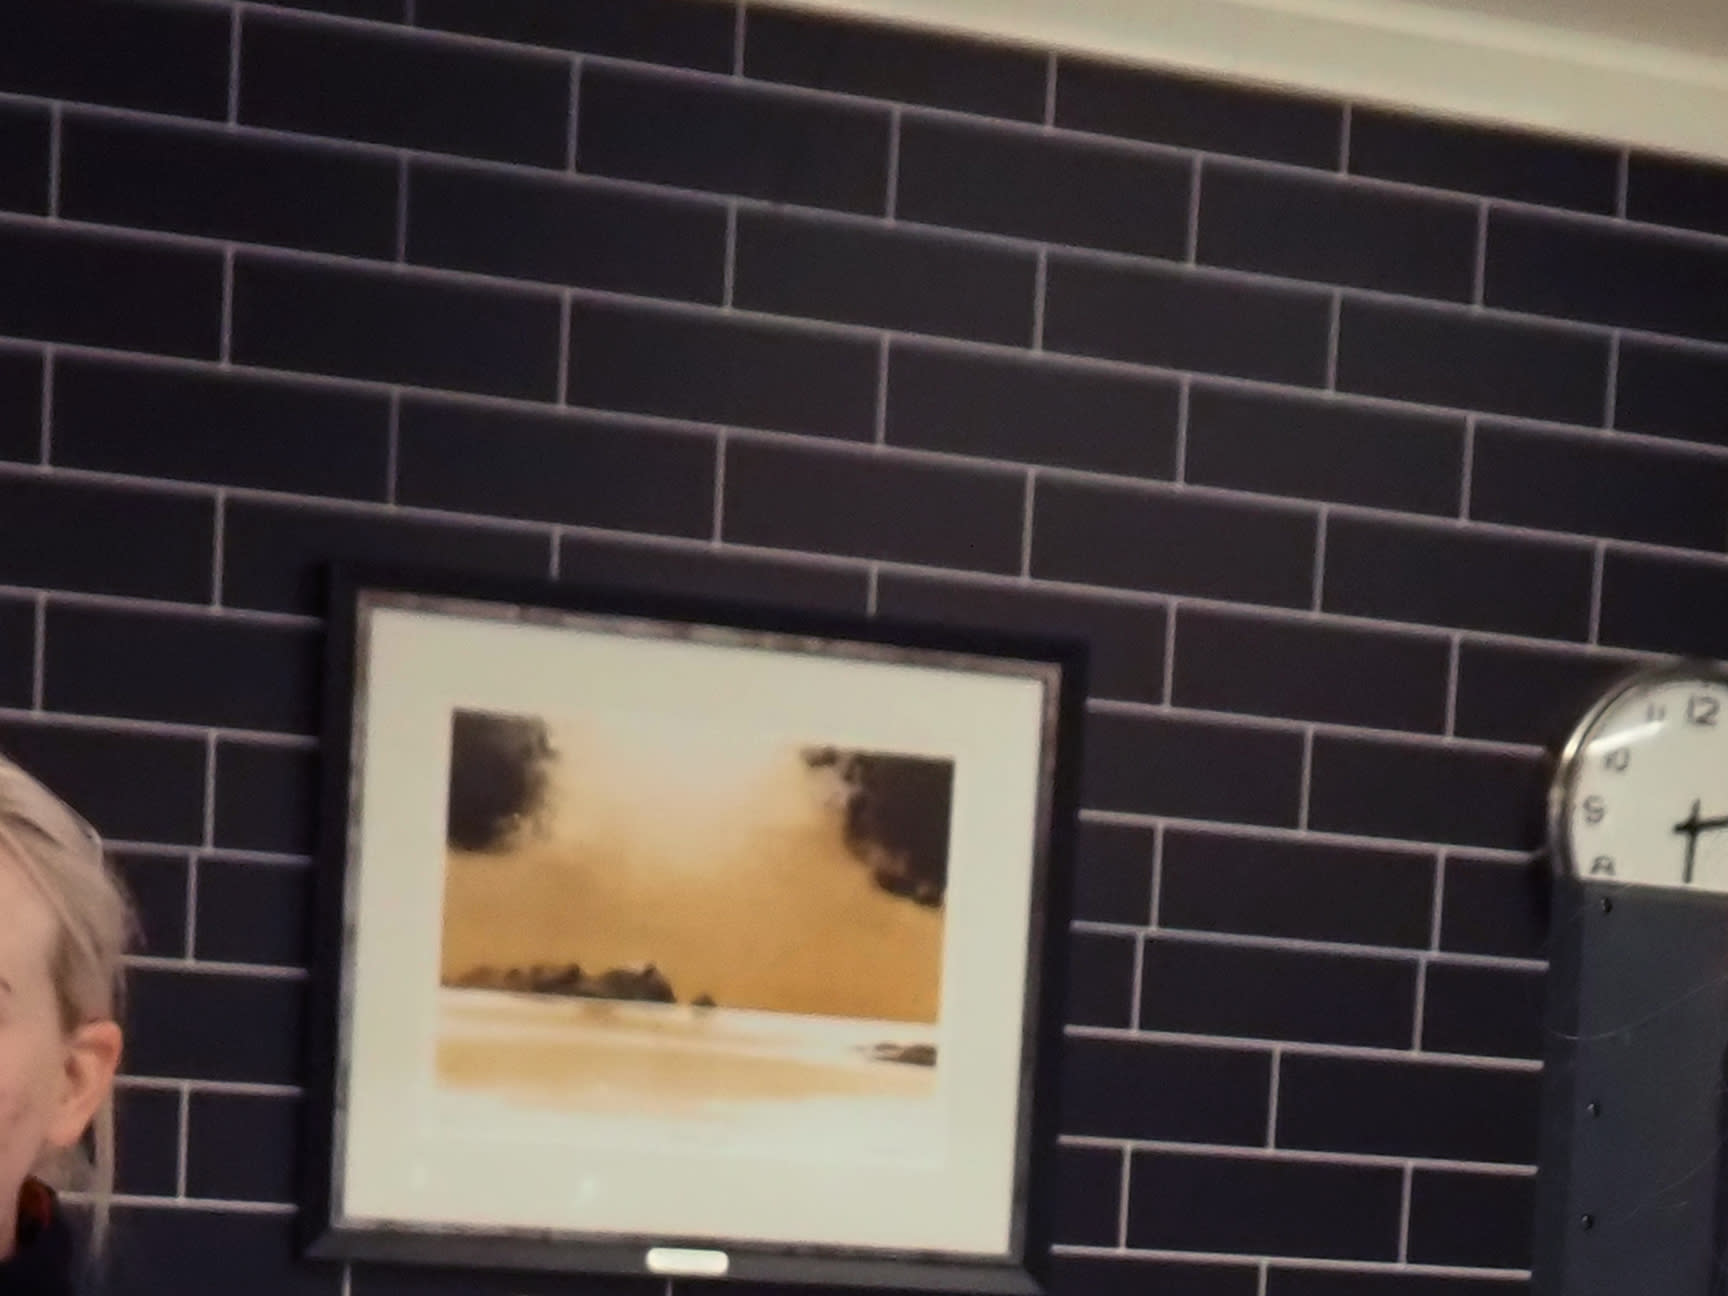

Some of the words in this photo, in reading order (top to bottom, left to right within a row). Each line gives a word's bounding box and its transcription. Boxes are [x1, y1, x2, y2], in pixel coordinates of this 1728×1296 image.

[1685, 695, 1721, 727] 12
[1603, 749, 1630, 772] 10
[1582, 795, 1606, 825] 9
